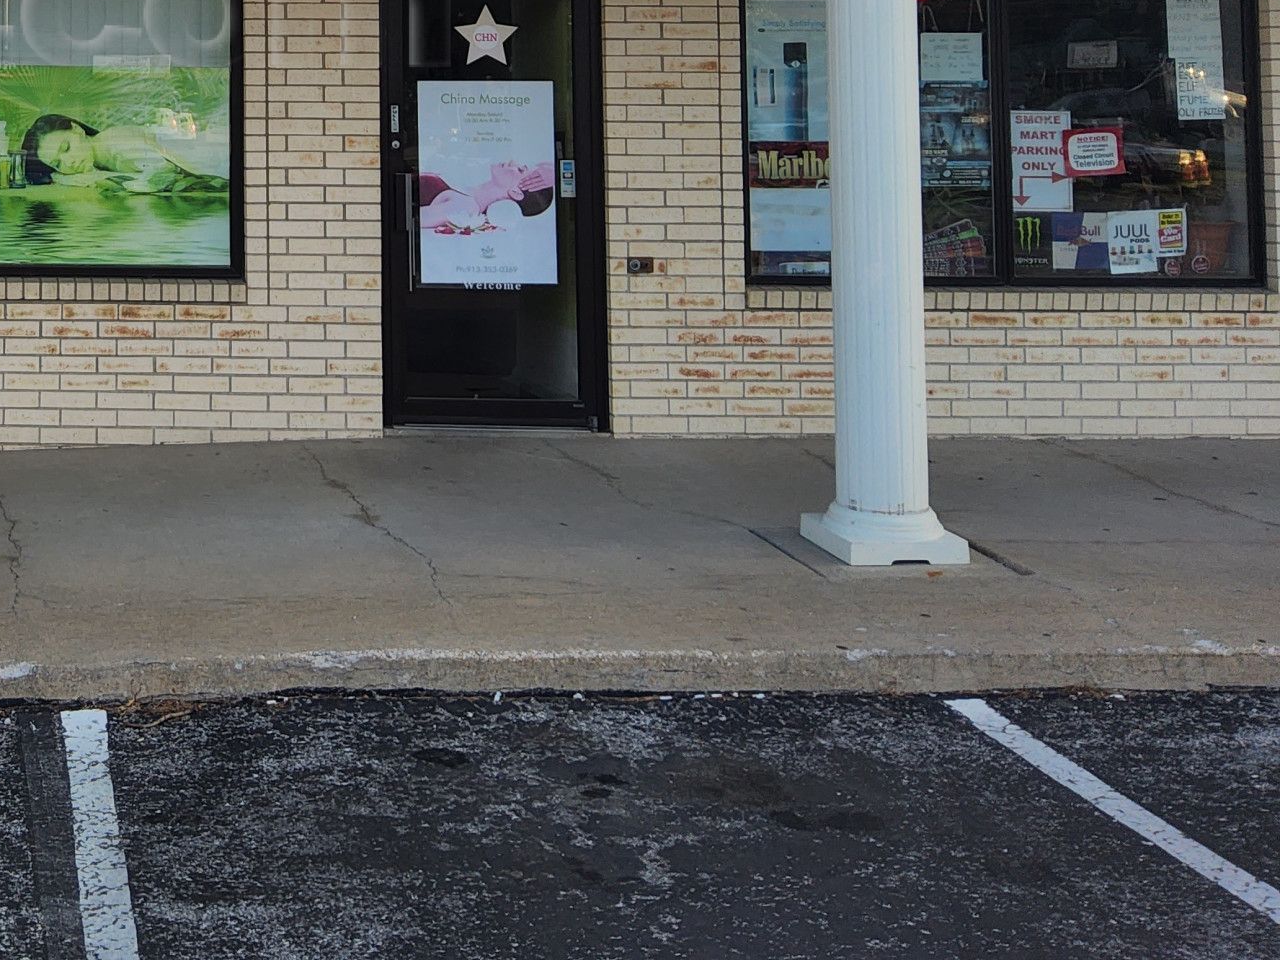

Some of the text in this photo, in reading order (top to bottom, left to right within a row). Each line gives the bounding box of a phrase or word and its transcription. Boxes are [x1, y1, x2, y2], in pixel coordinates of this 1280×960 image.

[474, 33, 498, 42] CHN
[440, 93, 531, 106] China Massage
[1015, 115, 1061, 125] SMOKE
[1020, 131, 1057, 140] MART
[1021, 161, 1057, 171] ONLY
[1074, 159, 1115, 168] Television
[1081, 225, 1100, 236] Bull
[1113, 224, 1150, 239] JUUL
